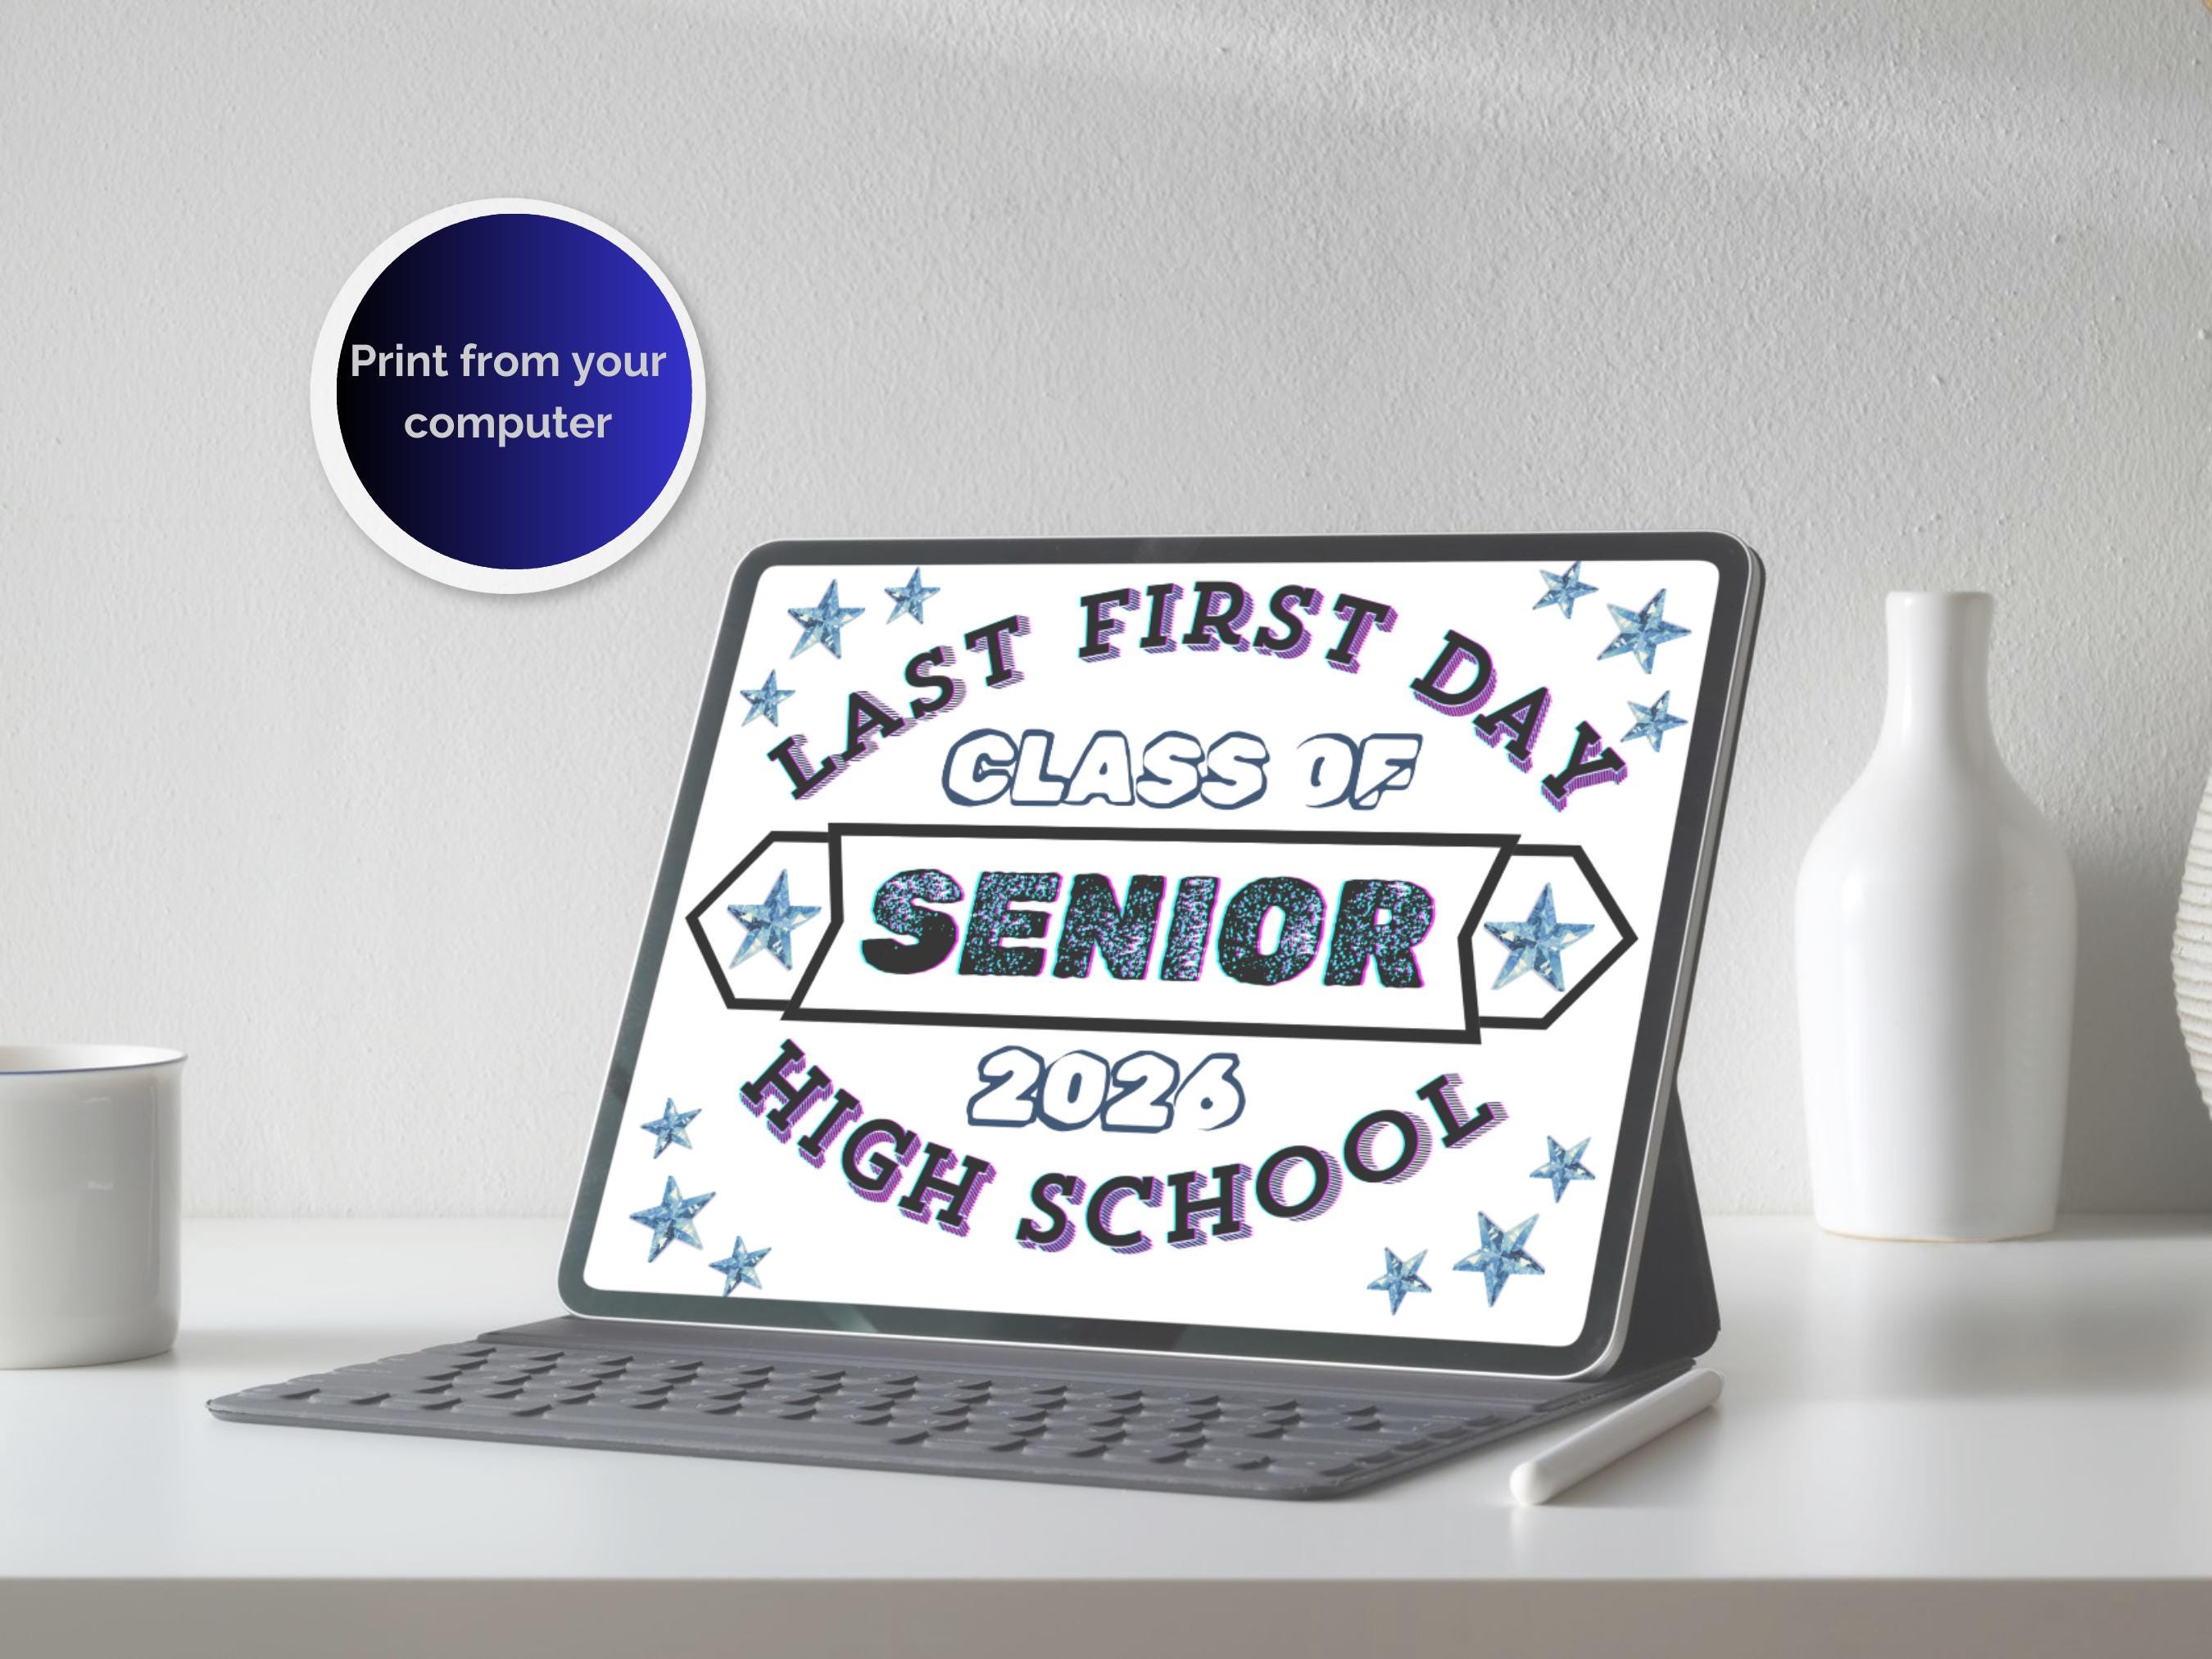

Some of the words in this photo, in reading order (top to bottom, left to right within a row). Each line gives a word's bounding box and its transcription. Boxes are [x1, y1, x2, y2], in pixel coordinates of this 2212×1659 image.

[767, 614, 1031, 800] LAST
[1078, 581, 1398, 675] FIRST
[1409, 628, 1627, 813] DAY
[941, 728, 1271, 810] CLASS
[1296, 732, 1423, 810] OF
[859, 868, 1435, 989] SENIOR
[739, 1038, 996, 1238] HIGH
[1014, 1072, 1509, 1254] SCHOOL
[967, 1045, 1246, 1134] 2026
